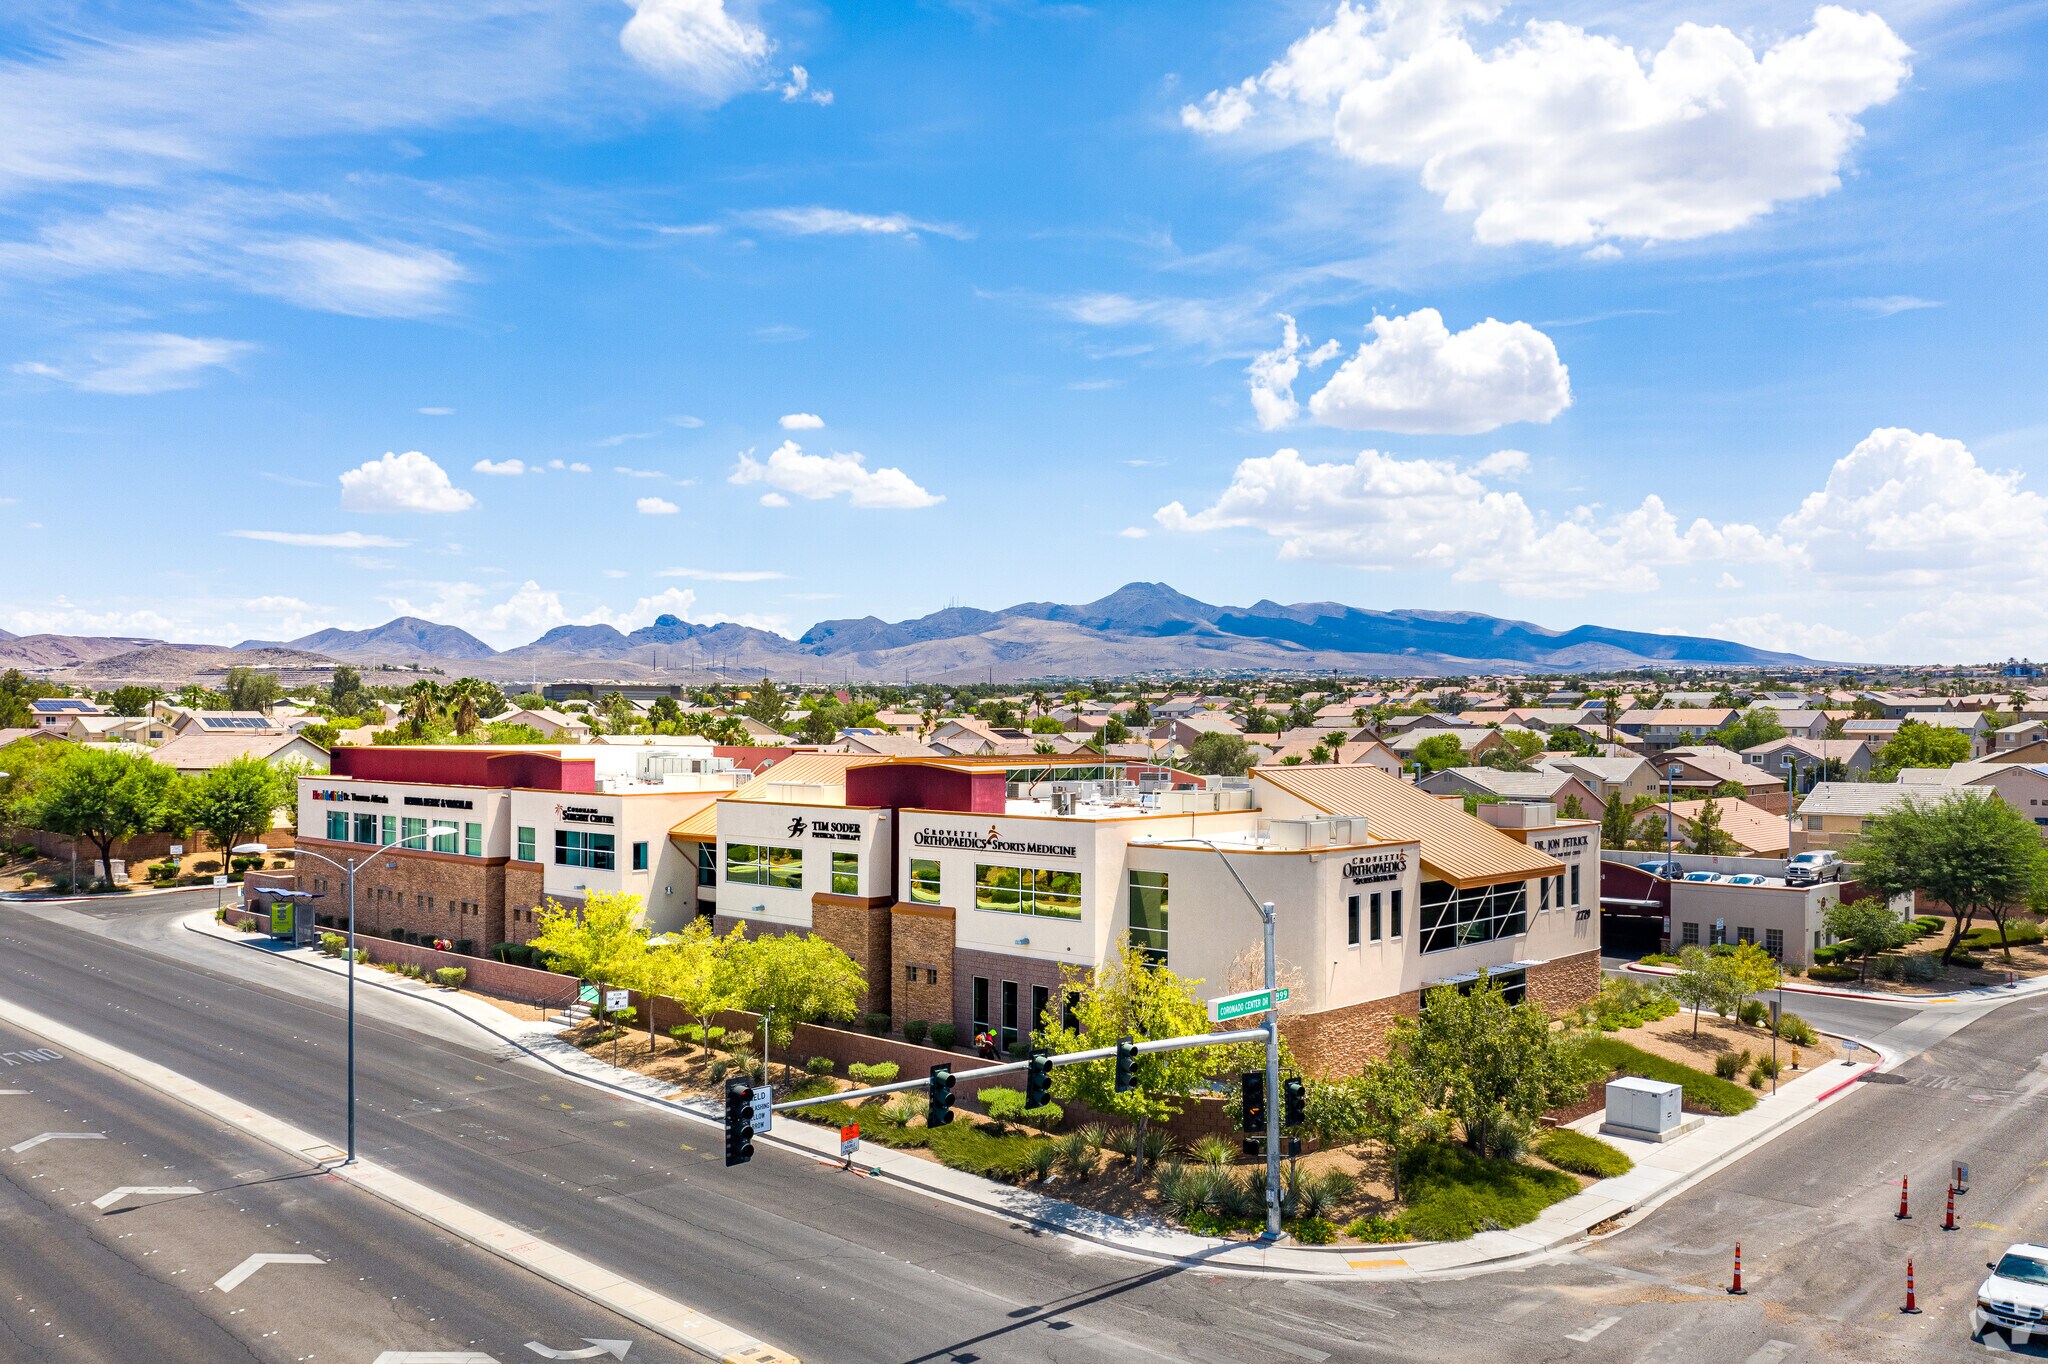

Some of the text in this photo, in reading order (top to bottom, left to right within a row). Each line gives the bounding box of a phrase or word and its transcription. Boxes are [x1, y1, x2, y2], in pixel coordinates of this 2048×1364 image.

[812, 821, 861, 834] TIM SODER
[923, 827, 978, 838] CROVETTI
[914, 831, 987, 849] ORTHOPAEDICS
[992, 839, 1026, 852] SPORTS
[1026, 842, 1076, 856] MEDICINE
[1547, 838, 1560, 852] JON
[1352, 853, 1399, 864] CROVETTI
[1343, 860, 1406, 877] ORTHOPAEDICS
[1220, 1003, 1244, 1015] CORONADO
[1244, 999, 1262, 1009] CENTER
[753, 1091, 766, 1101] ELD
